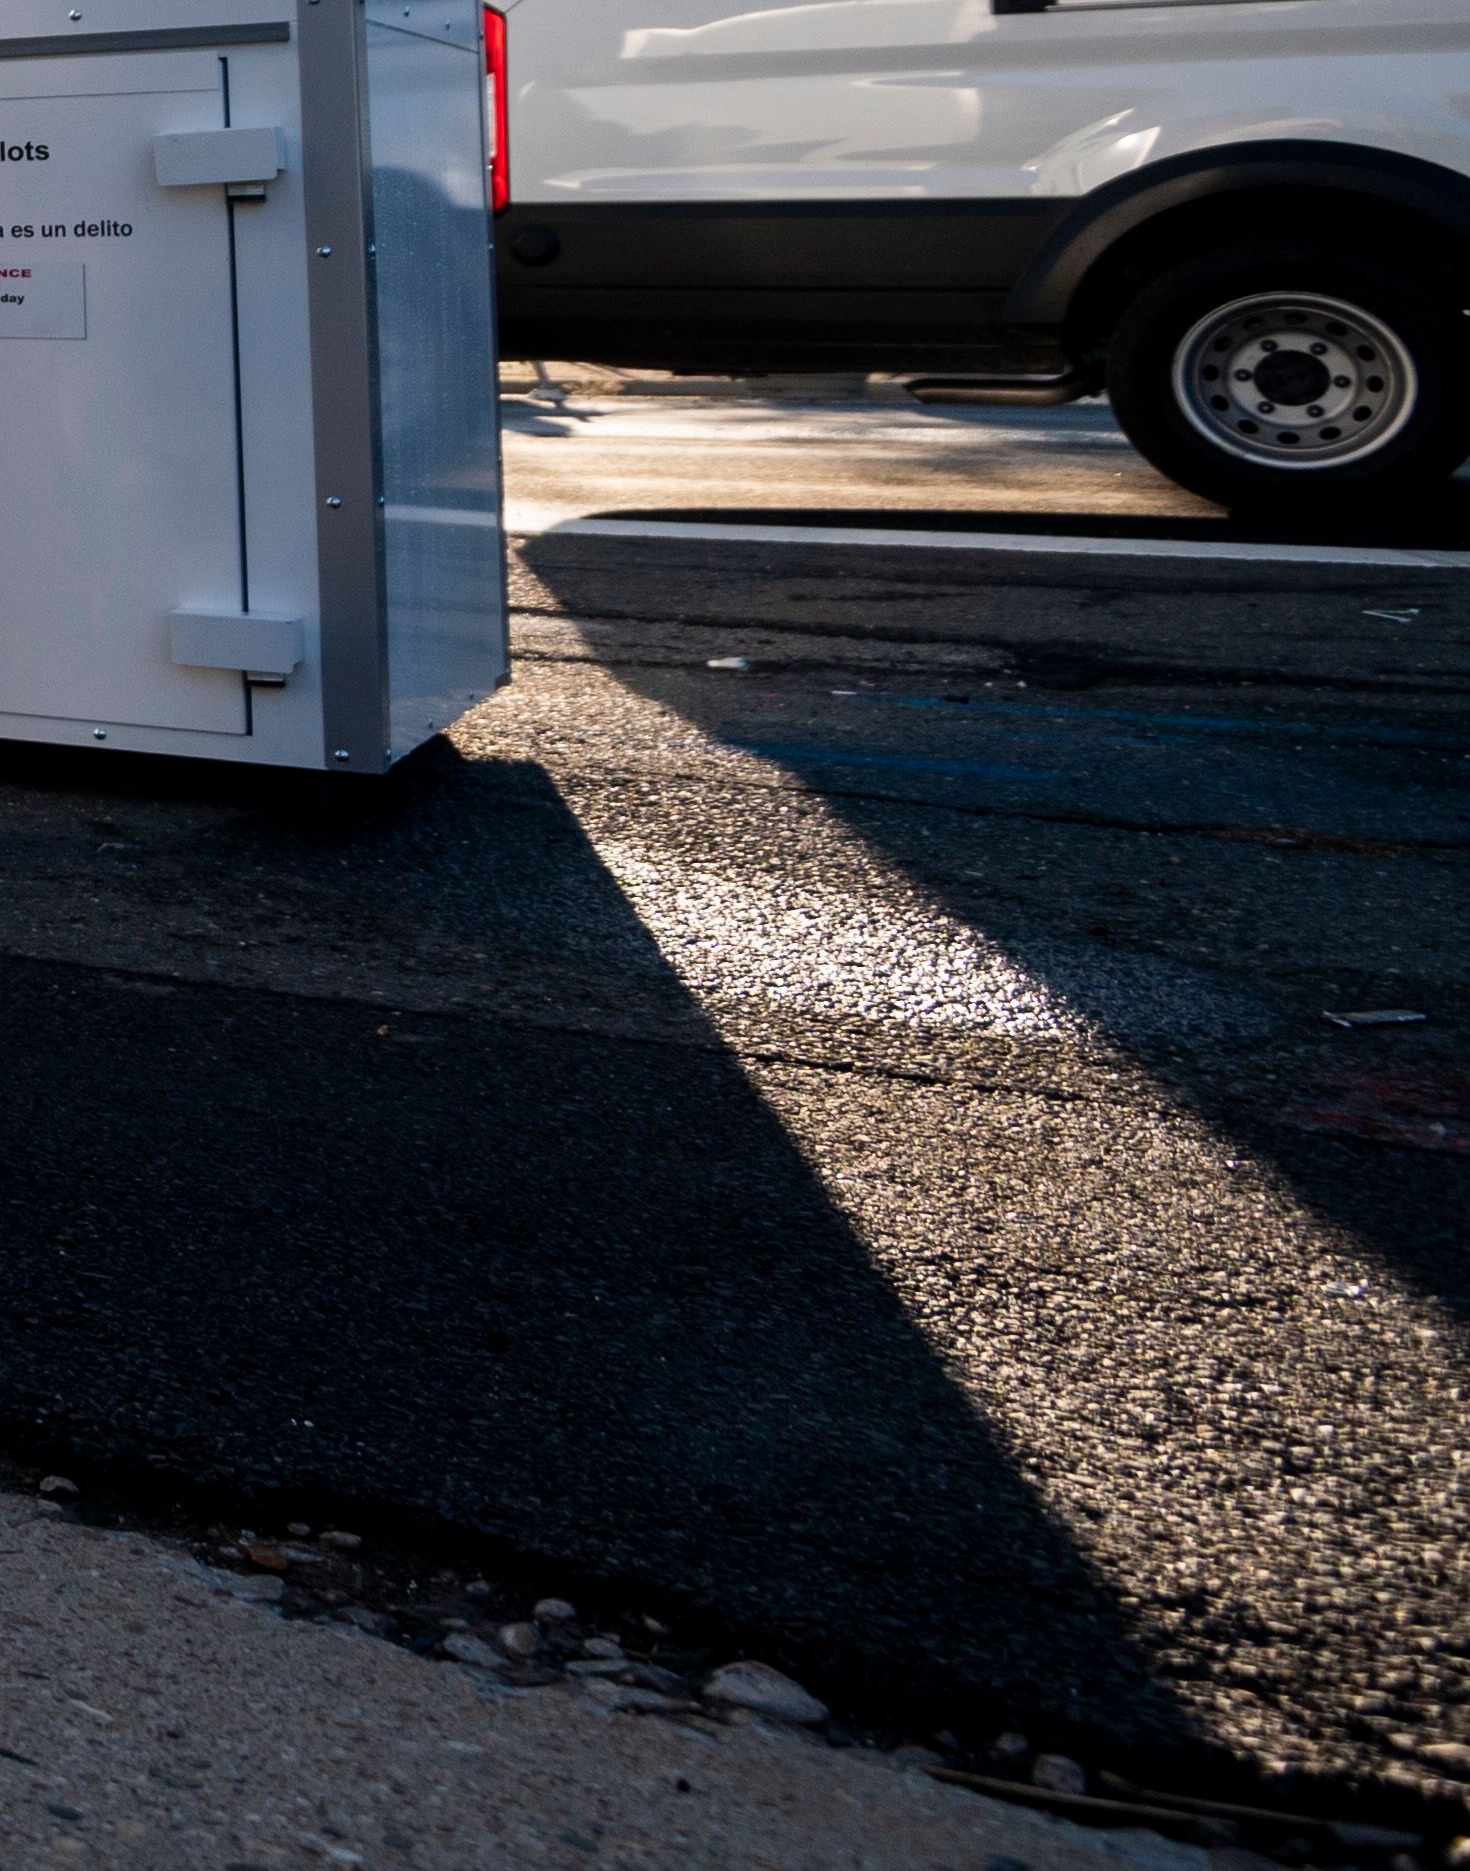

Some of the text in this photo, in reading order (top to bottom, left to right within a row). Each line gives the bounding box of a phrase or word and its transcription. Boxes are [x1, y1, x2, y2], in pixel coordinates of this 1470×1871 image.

[11, 224, 34, 239] es
[41, 222, 67, 238] un
[73, 220, 133, 238] delito
[0, 293, 25, 305] day
